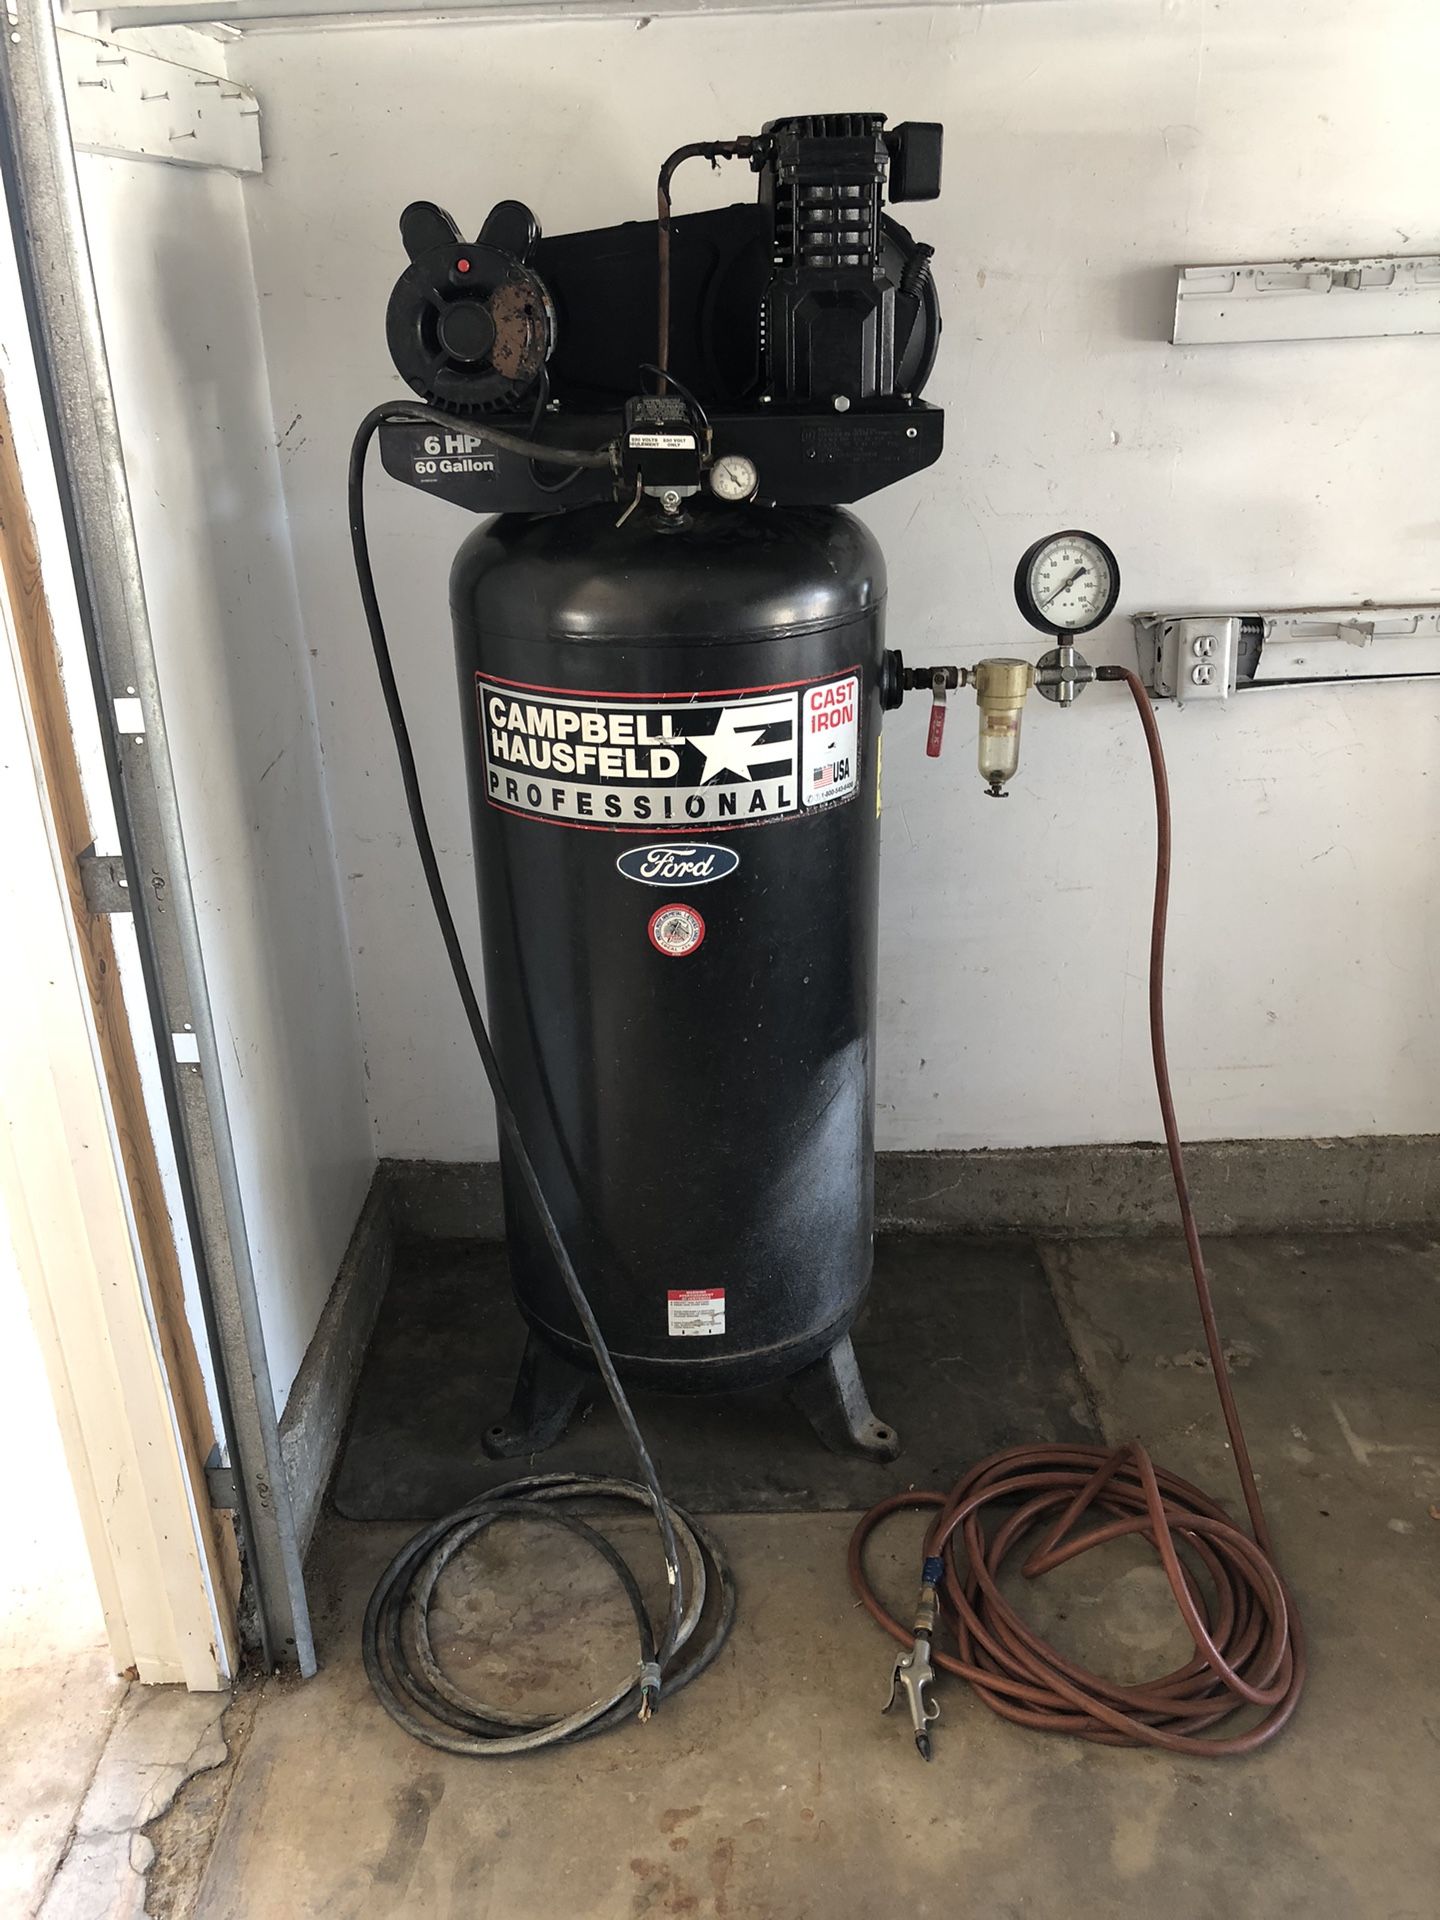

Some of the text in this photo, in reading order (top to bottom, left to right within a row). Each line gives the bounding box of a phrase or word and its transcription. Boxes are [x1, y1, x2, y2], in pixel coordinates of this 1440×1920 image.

[424, 434, 481, 455] 6 HP
[415, 459, 494, 474] 60 Gallon
[811, 681, 855, 711] CAST
[489, 697, 686, 746] CAMPBELL
[811, 703, 853, 733] IRON
[492, 728, 680, 779] HAUSFELD
[833, 757, 850, 782] USA
[490, 771, 791, 819] PROFESSIONAL
[640, 848, 715, 878] Ford
